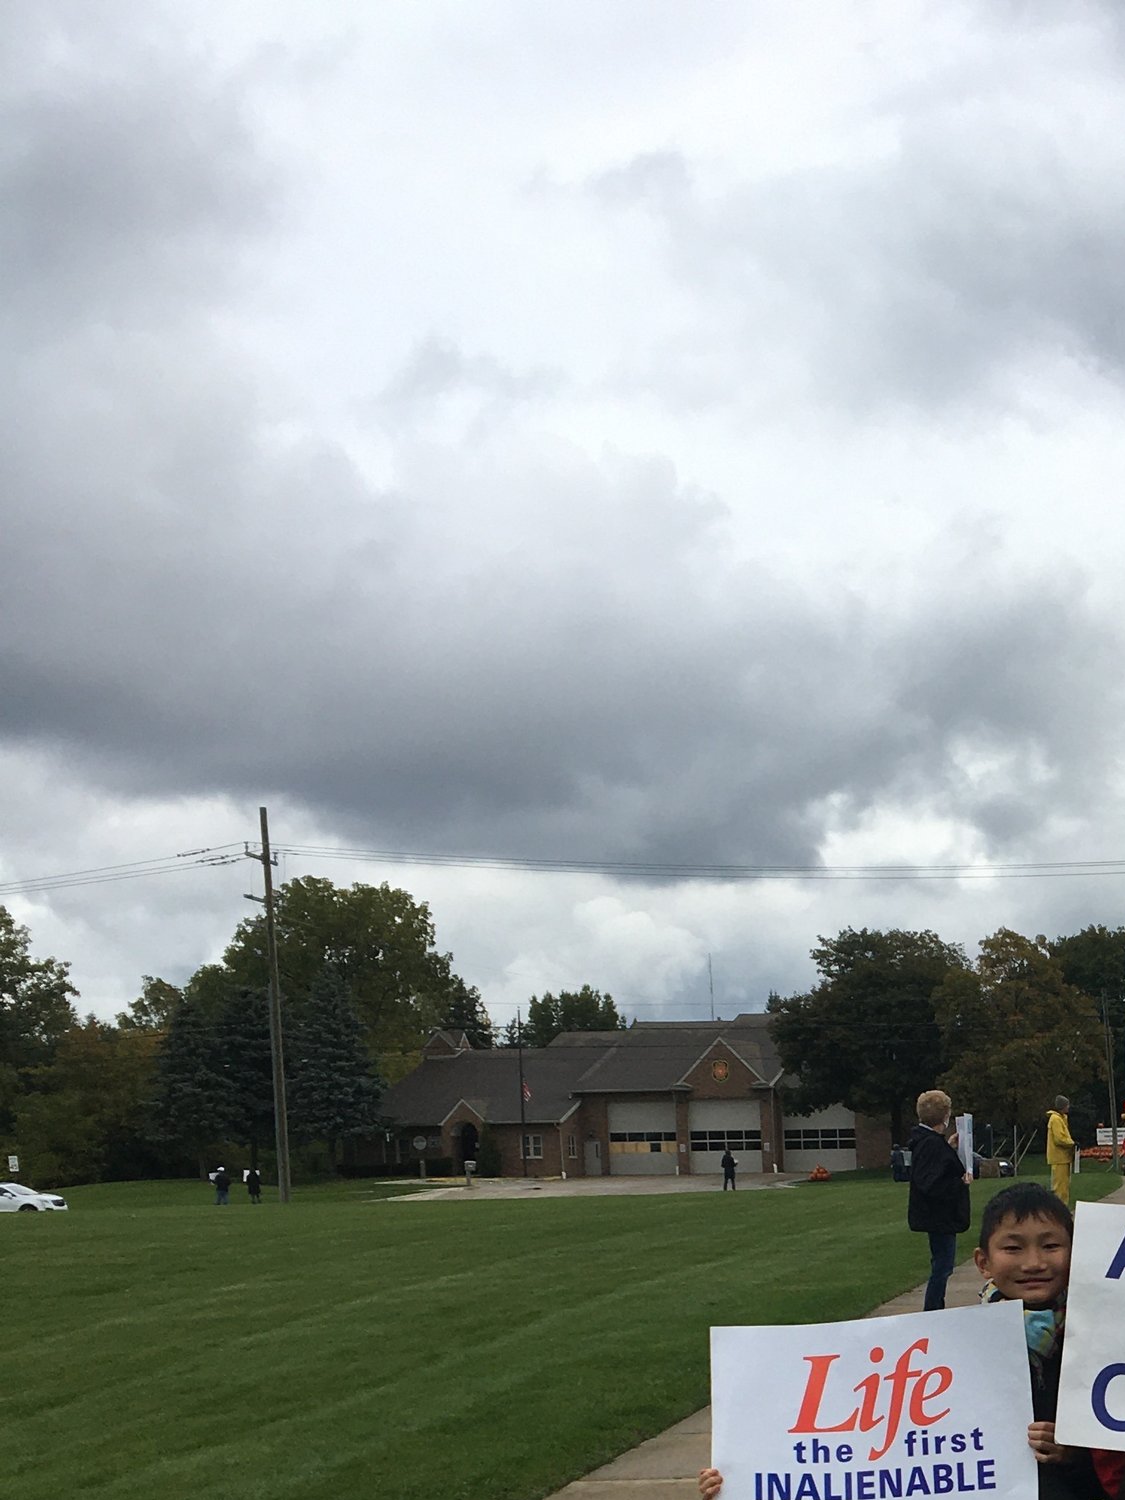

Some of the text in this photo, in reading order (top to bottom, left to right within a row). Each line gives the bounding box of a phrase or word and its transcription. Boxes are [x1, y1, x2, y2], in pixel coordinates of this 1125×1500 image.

[788, 1338, 953, 1461] Life
[792, 1427, 984, 1463] the first
